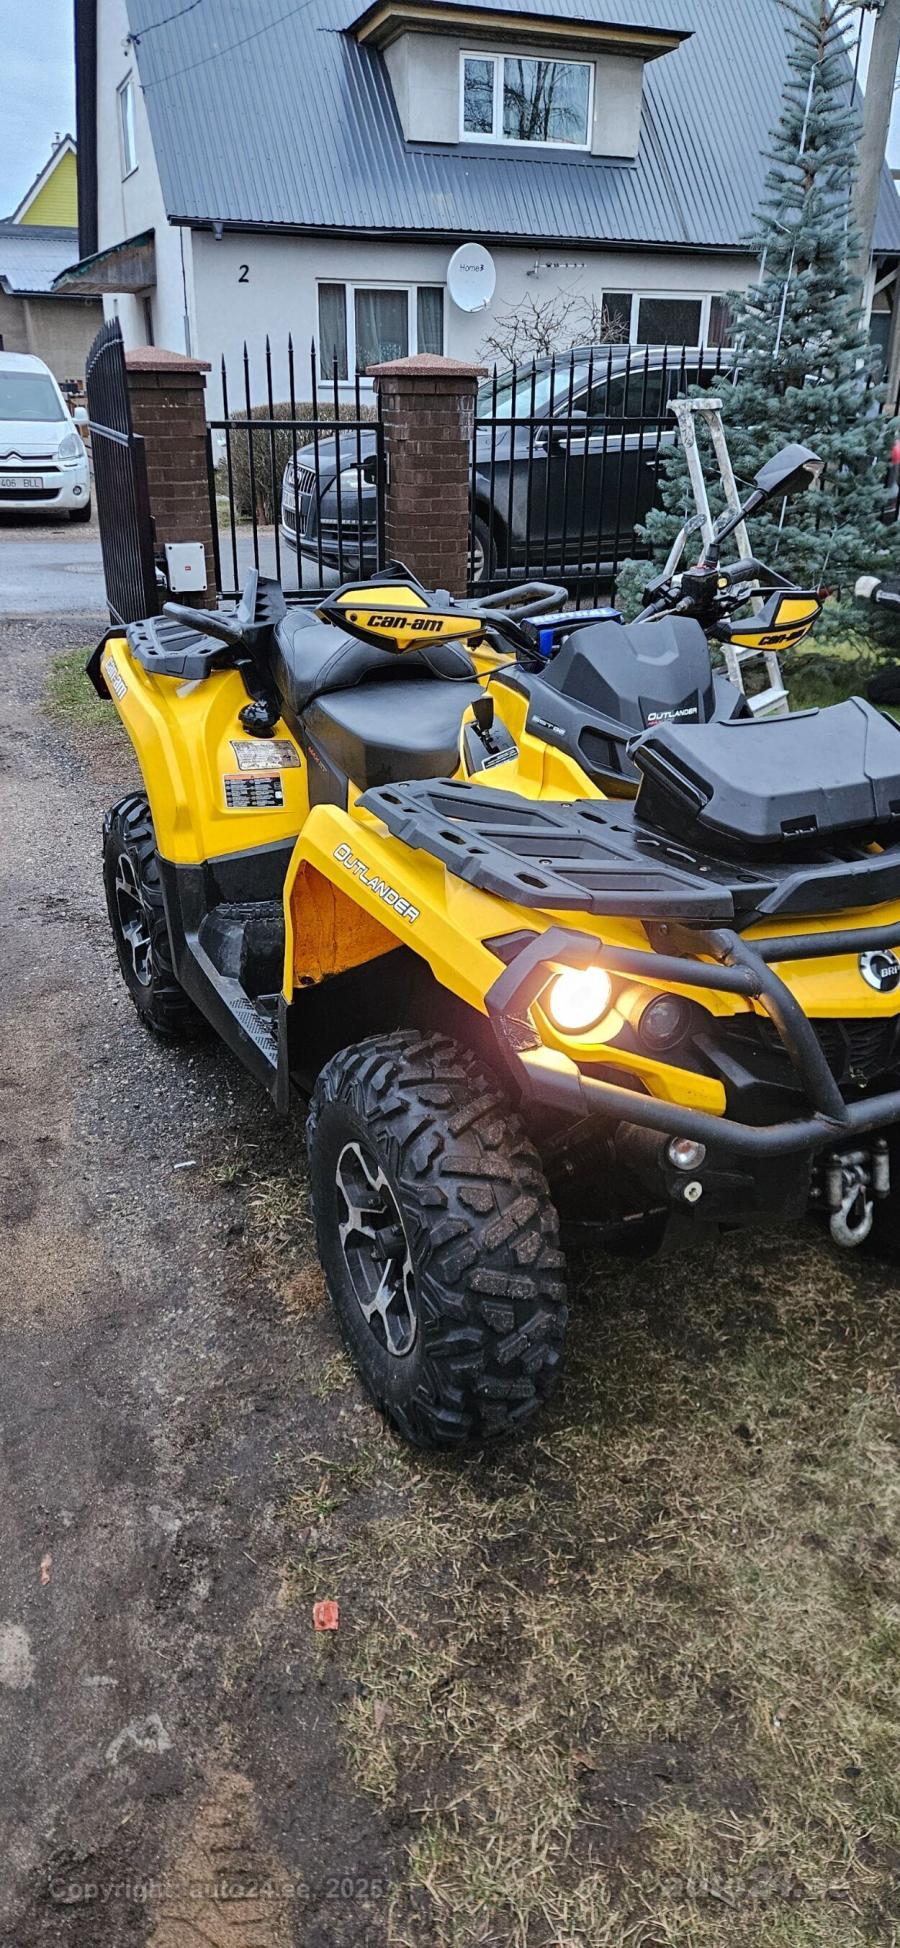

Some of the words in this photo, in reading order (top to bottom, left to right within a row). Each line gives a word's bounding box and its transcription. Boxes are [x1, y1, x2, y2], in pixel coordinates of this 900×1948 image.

[238, 264, 250, 283] 2
[367, 615, 444, 632] can-am
[647, 707, 698, 721] OUTLANDER
[332, 842, 421, 925] OUTLANDER
